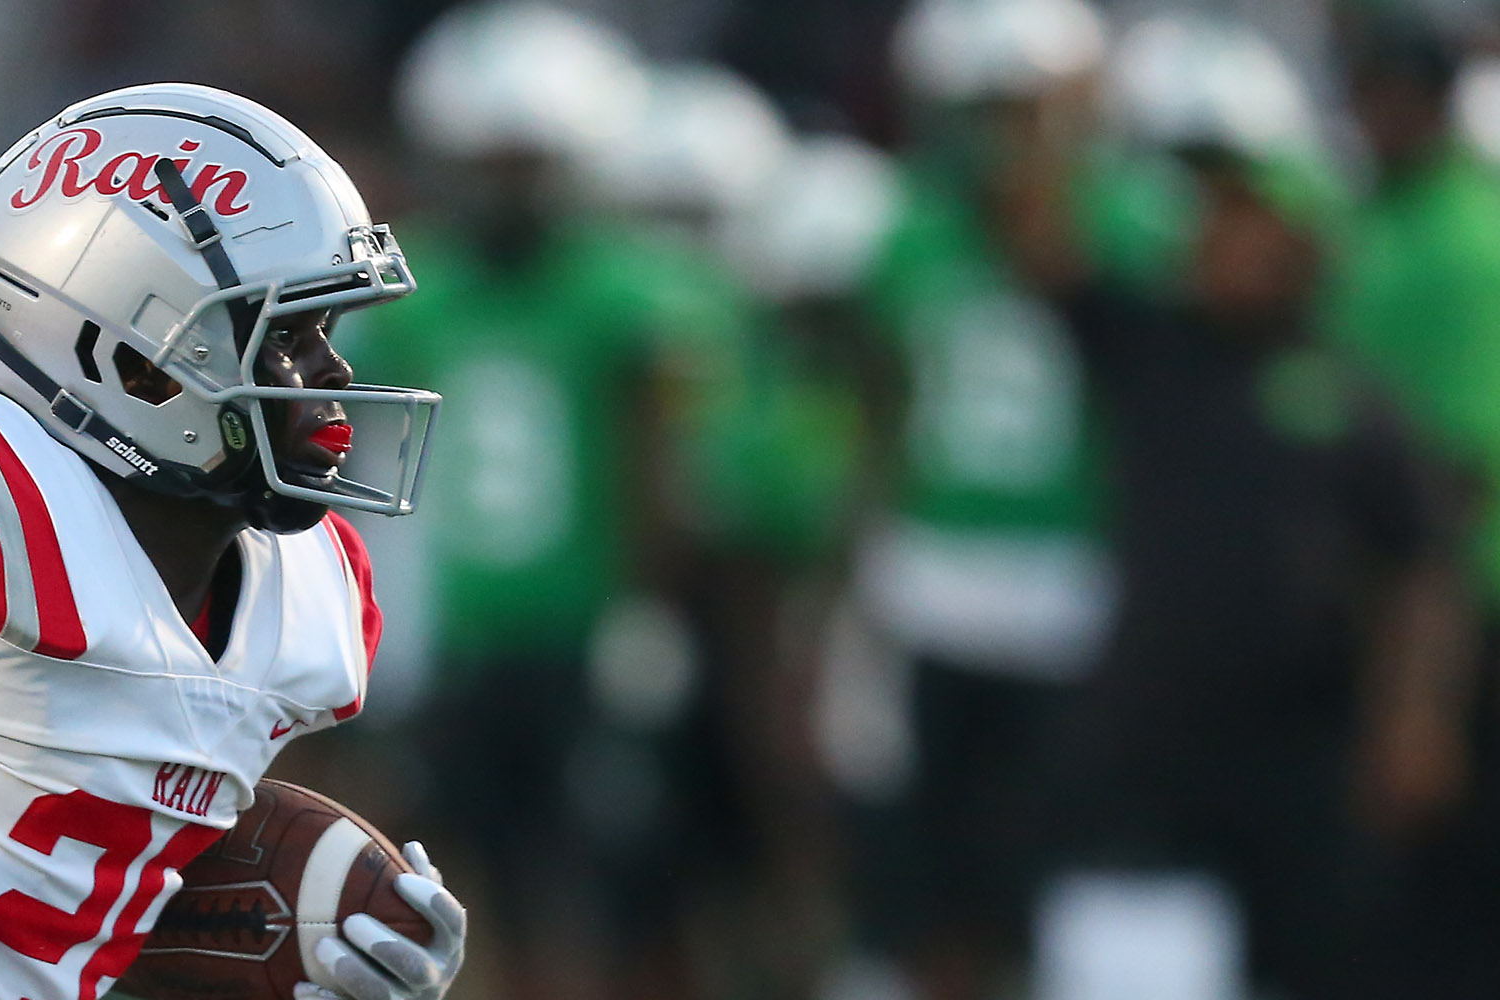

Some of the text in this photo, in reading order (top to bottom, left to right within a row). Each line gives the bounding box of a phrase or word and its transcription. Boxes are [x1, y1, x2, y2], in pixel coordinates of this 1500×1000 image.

[11, 127, 250, 216] Rain
[105, 436, 159, 476] schutt
[151, 761, 227, 817] RAIN
